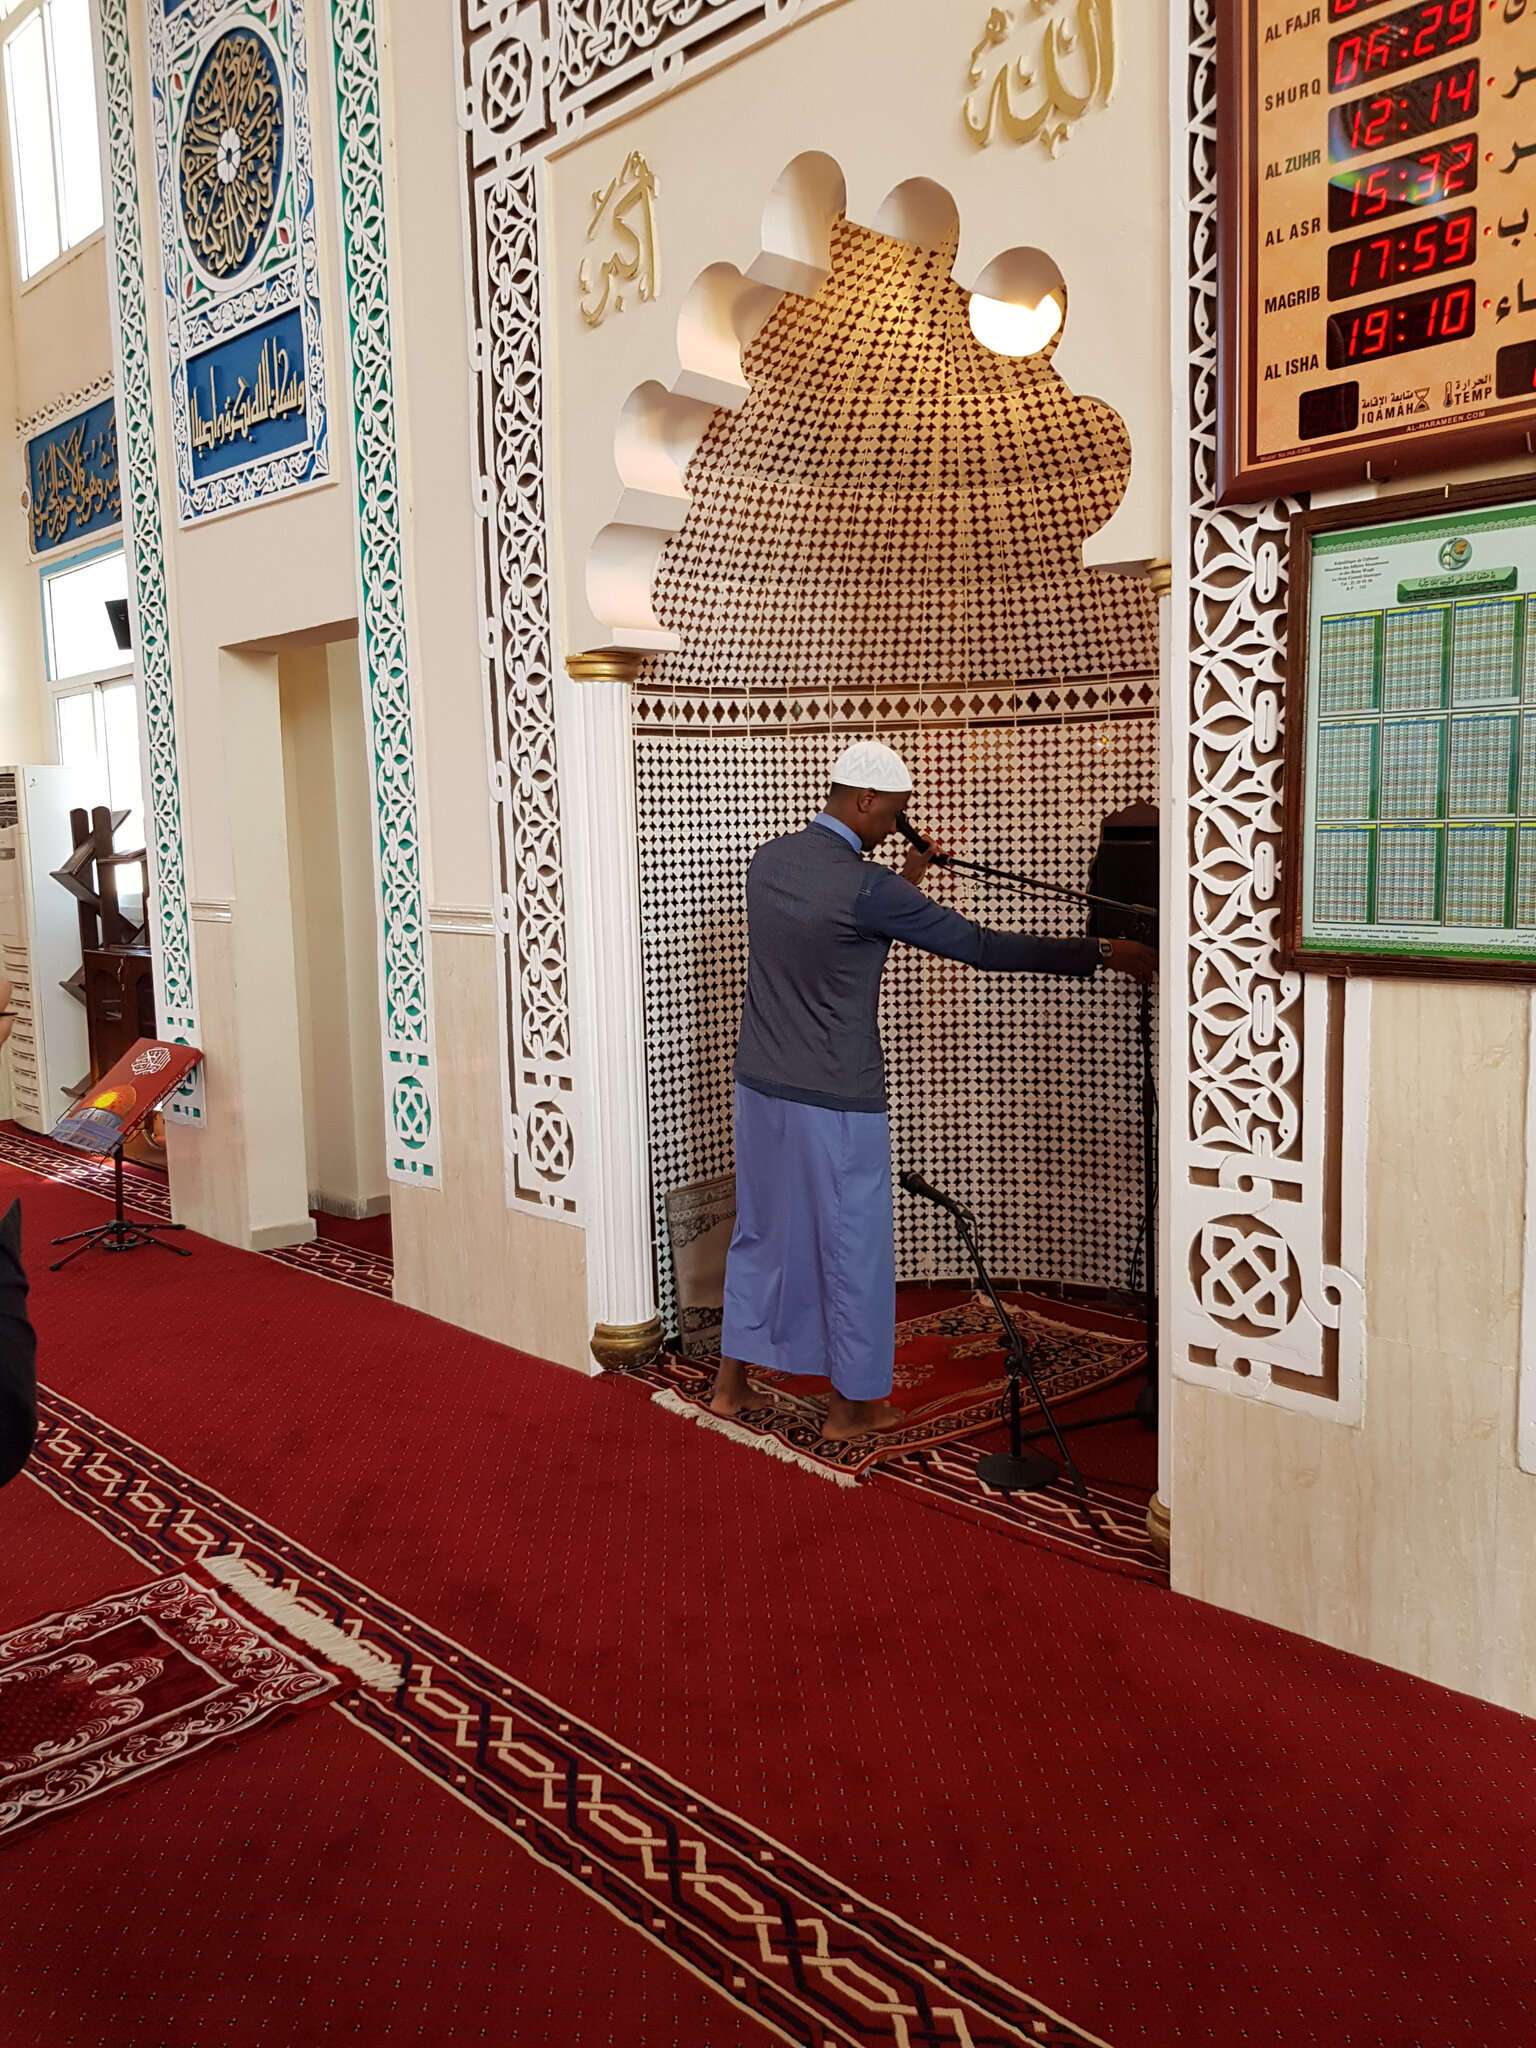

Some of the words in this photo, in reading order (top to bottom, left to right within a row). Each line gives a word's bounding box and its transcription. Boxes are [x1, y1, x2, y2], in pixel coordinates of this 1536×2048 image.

[1264, 27, 1282, 43] AL
[1285, 8, 1321, 33] FAJR
[1264, 78, 1321, 111] SHURQ
[1351, 69, 1475, 149] 12:14
[1264, 163, 1283, 180] AL
[1285, 149, 1321, 173] ZUHR
[1351, 141, 1473, 218] 15:32
[1265, 228, 1284, 247] AL
[1289, 217, 1321, 240] ASR
[1350, 216, 1471, 288] 17:59
[1264, 286, 1320, 314] MAGRIB
[1348, 288, 1470, 356] 19:10
[1264, 363, 1281, 380] AL
[1285, 354, 1319, 376] ISHA
[1454, 386, 1493, 406] TEMP
[1455, 374, 1492, 391] الحرارة
[1361, 403, 1414, 424] IQAMAH
[1405, 410, 1486, 432] AL-HARAMEEN.COM
